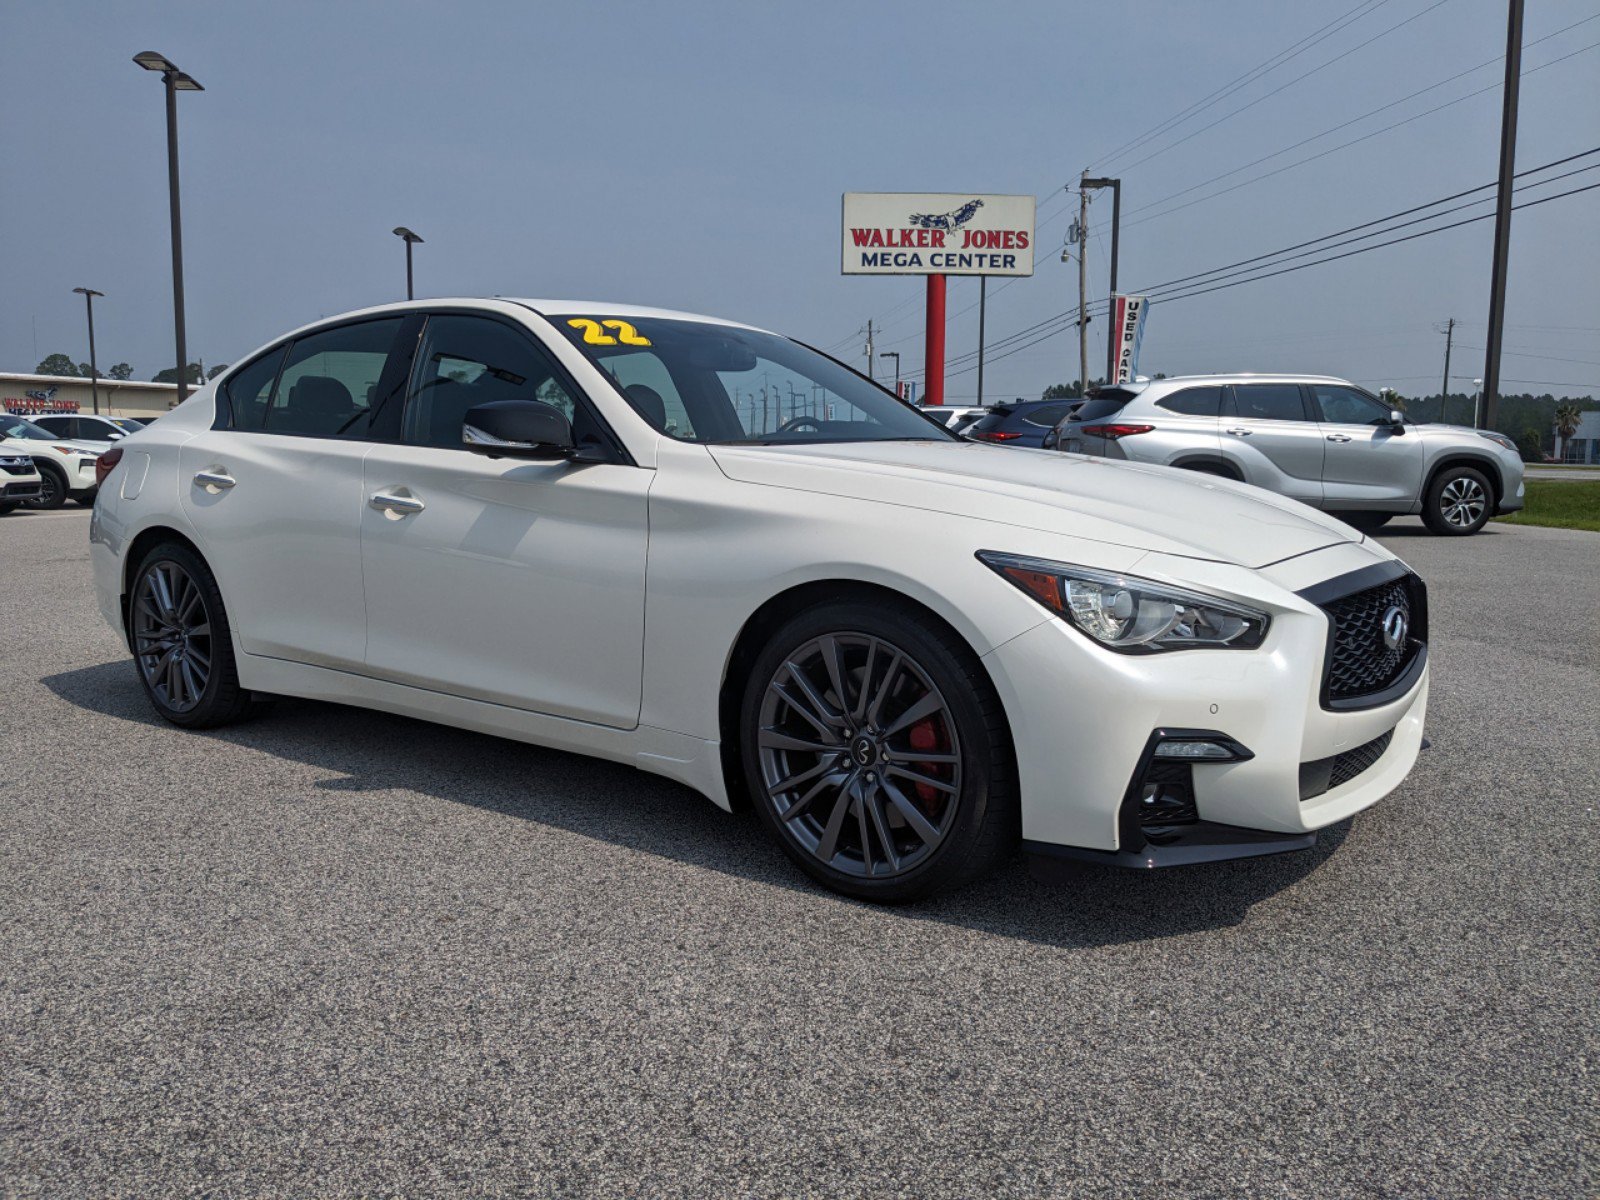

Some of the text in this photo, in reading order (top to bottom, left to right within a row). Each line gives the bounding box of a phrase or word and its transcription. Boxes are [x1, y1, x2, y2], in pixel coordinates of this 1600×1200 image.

[850, 228, 1029, 249] WALKER JONES
[861, 252, 1016, 269] MEGA CENTER
[567, 318, 652, 346] 22
[1124, 302, 1140, 342] USED
[4, 398, 80, 410] WALKER JONES
